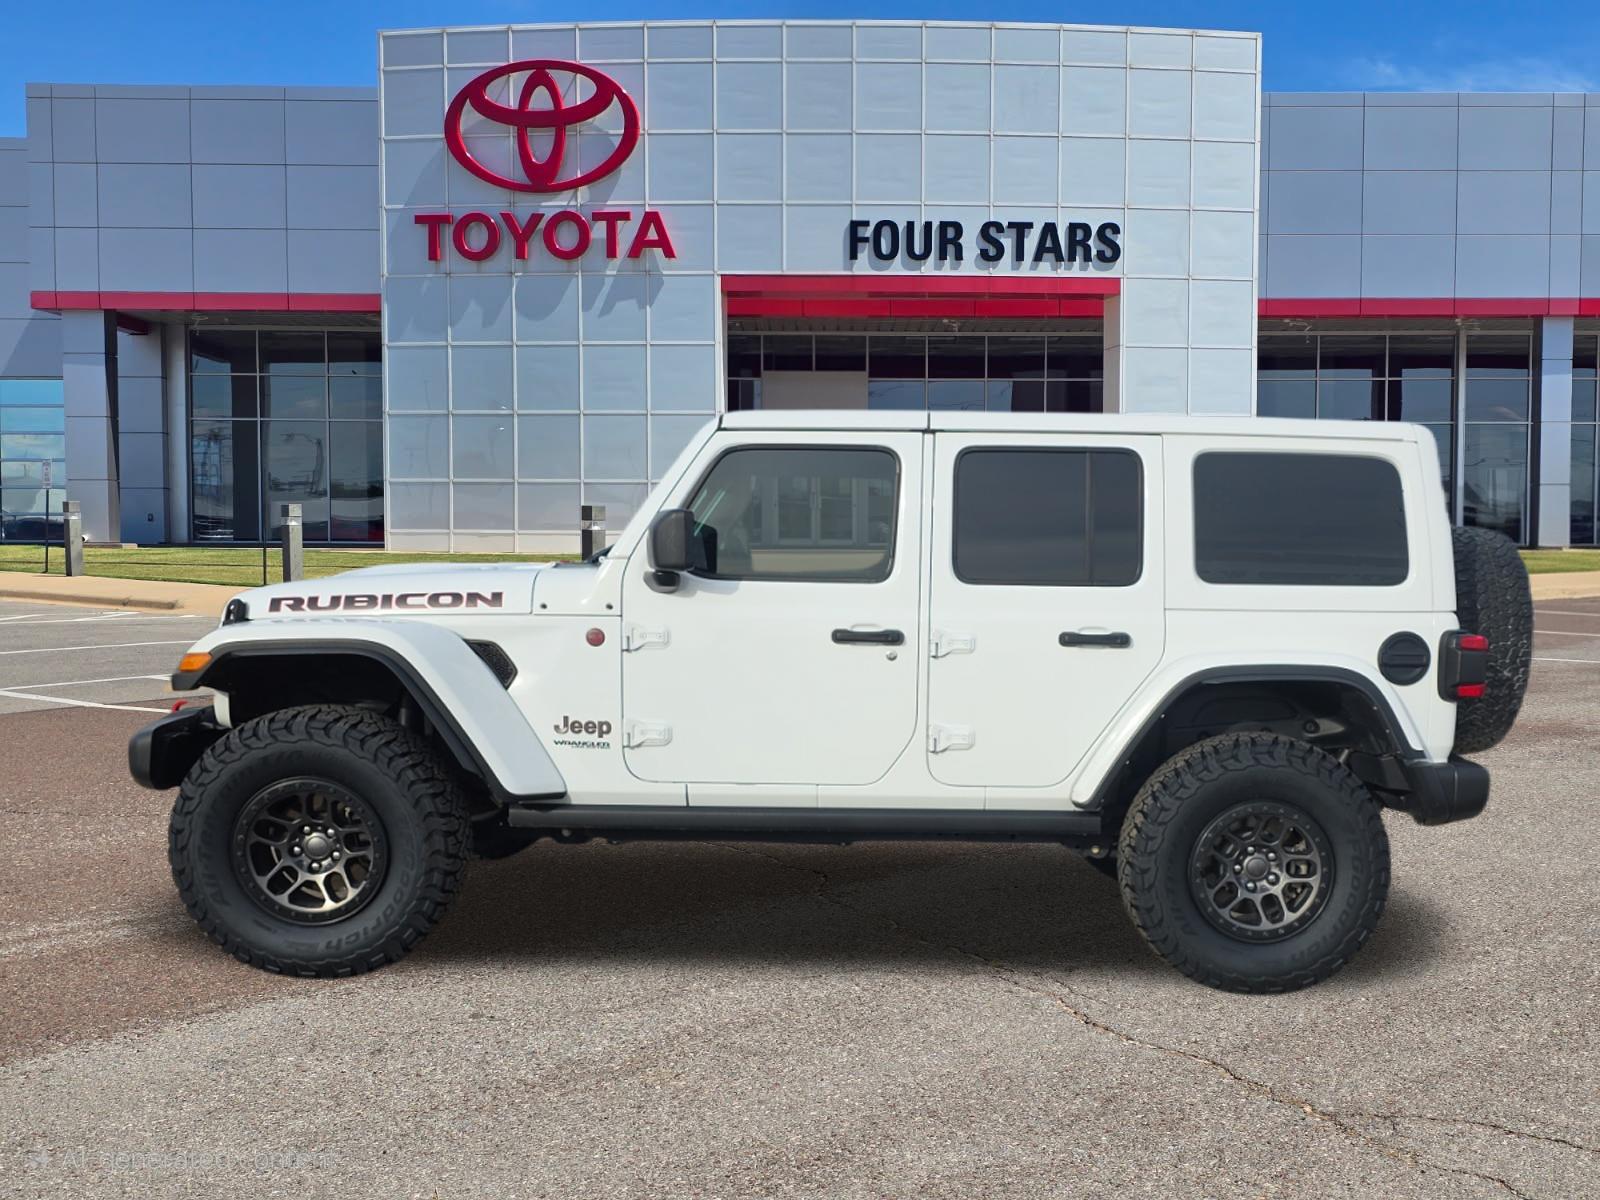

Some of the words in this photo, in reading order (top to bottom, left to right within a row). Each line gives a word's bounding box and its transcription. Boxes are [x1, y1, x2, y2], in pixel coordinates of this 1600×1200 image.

[414, 210, 677, 262] TOYOTA
[849, 219, 964, 261] FOUR
[979, 220, 1122, 264] STARS
[268, 591, 504, 613] RUBICON
[553, 715, 612, 738] Jeep
